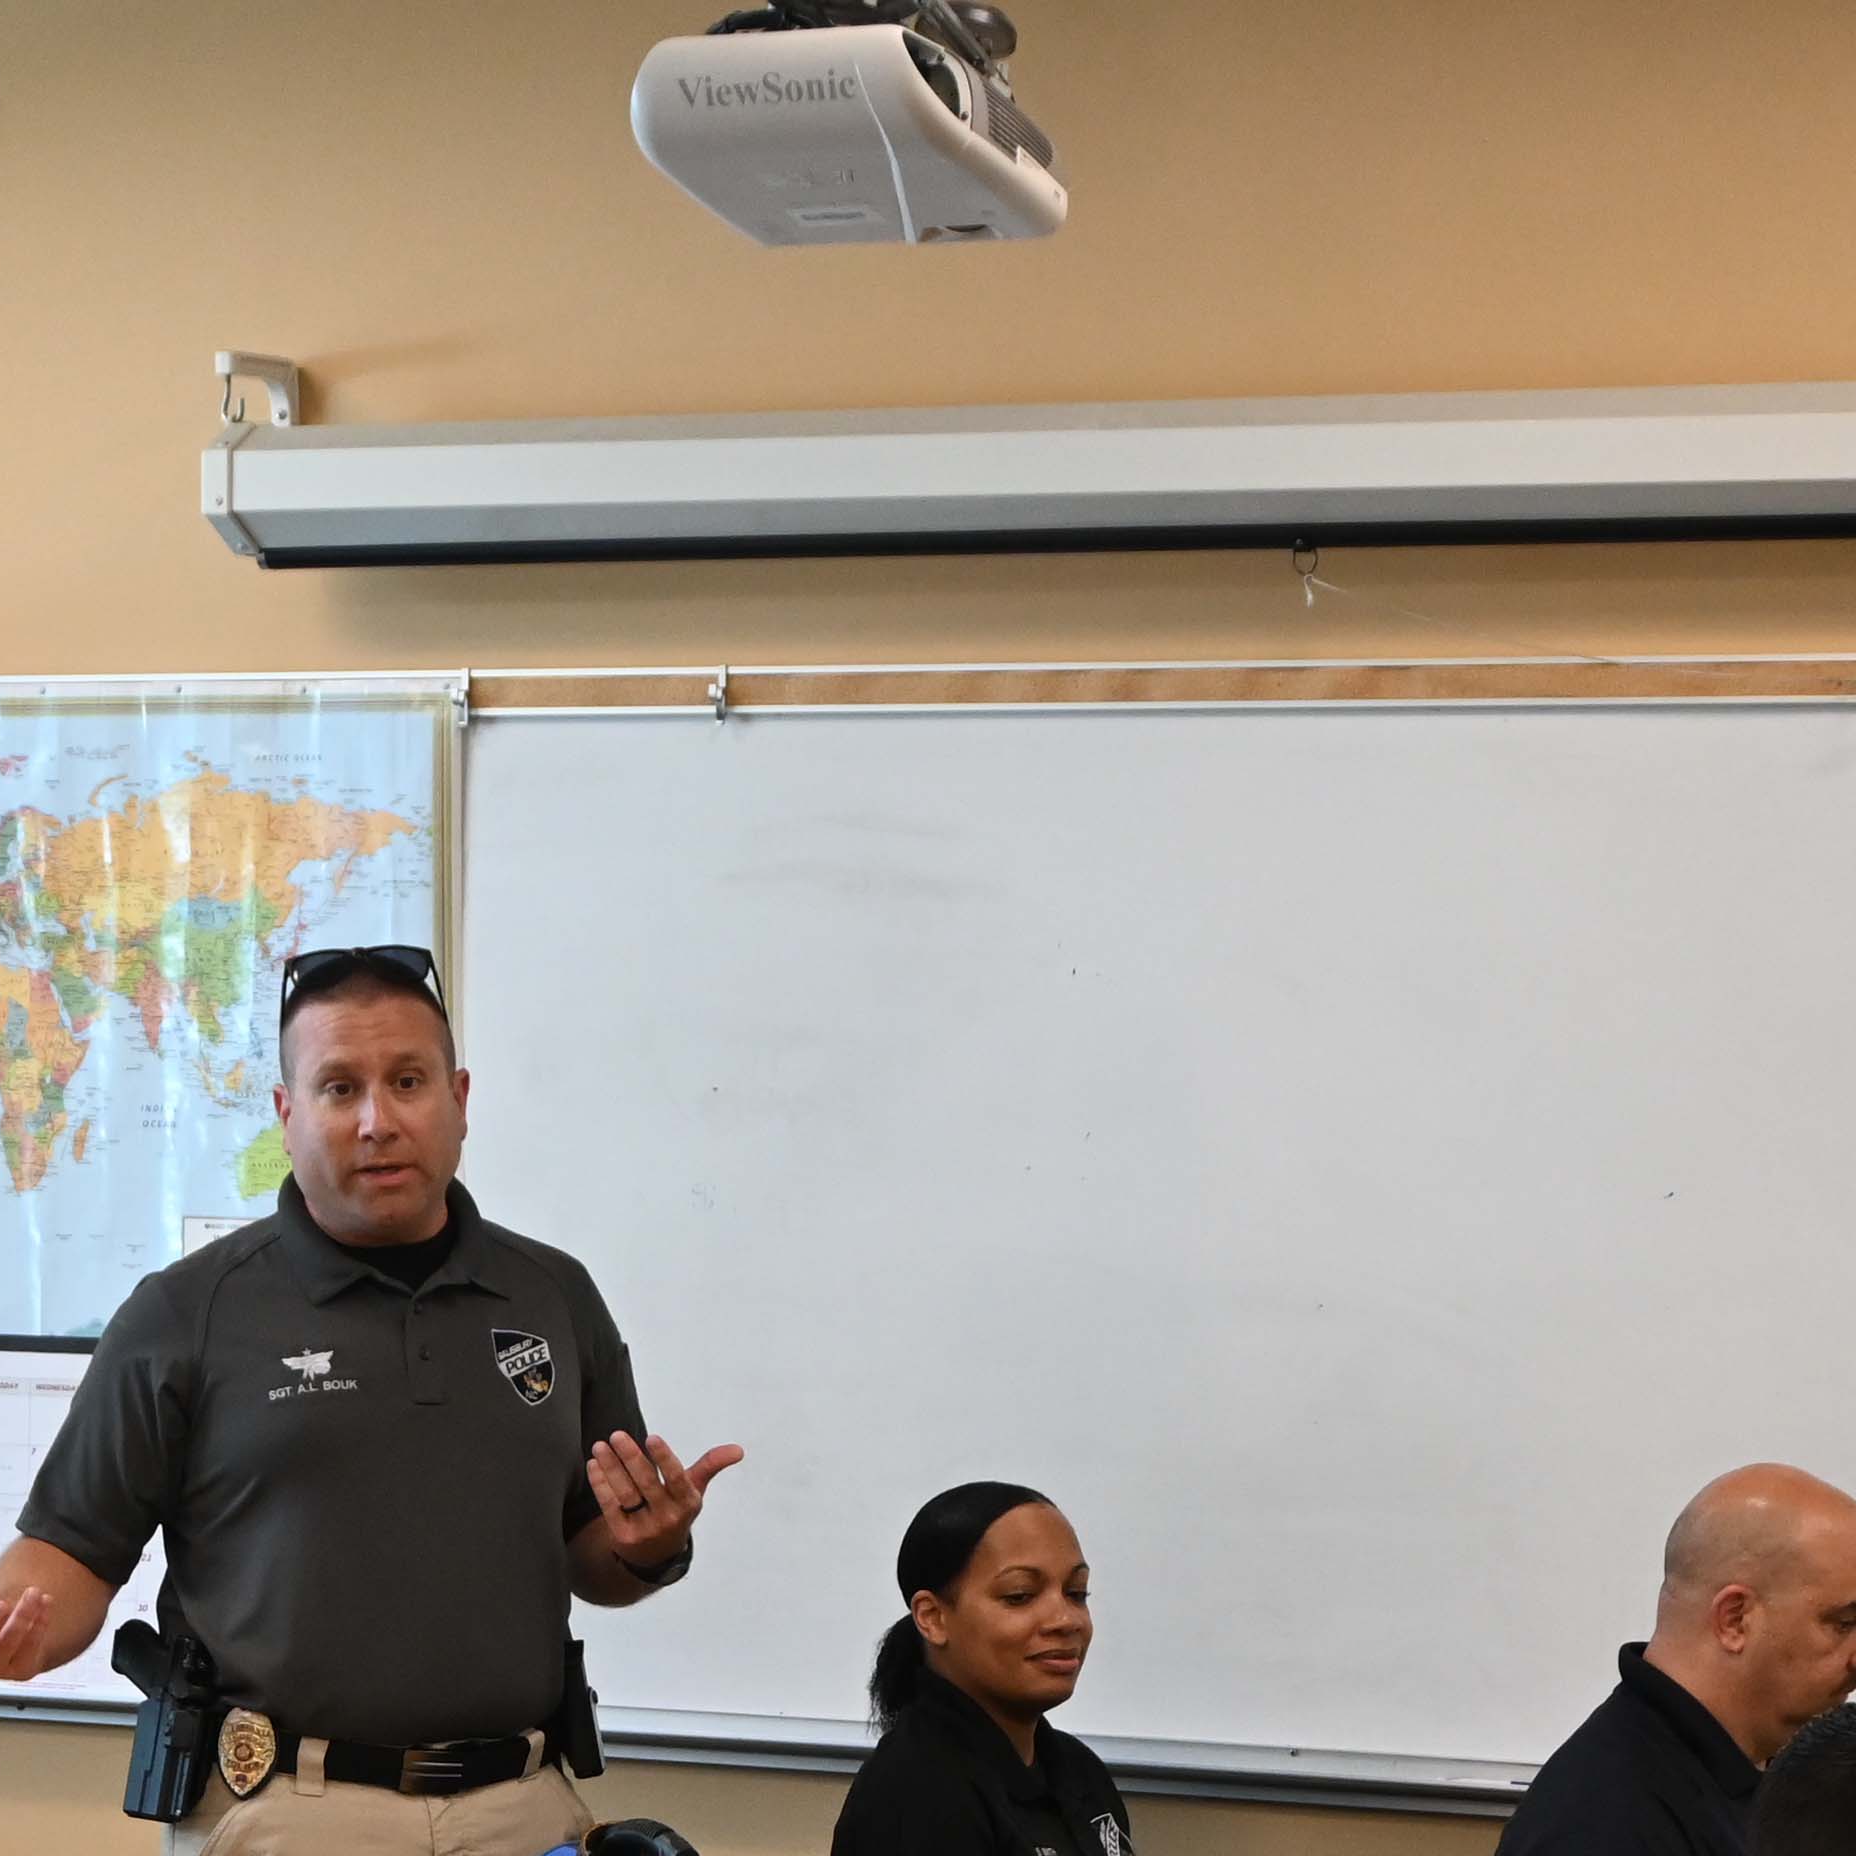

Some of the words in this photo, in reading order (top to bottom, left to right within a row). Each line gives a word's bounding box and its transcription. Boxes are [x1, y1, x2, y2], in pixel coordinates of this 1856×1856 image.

[678, 69, 859, 110] ViewSonic
[505, 1346, 548, 1375] POLICE
[268, 1386, 293, 1401] SGT
